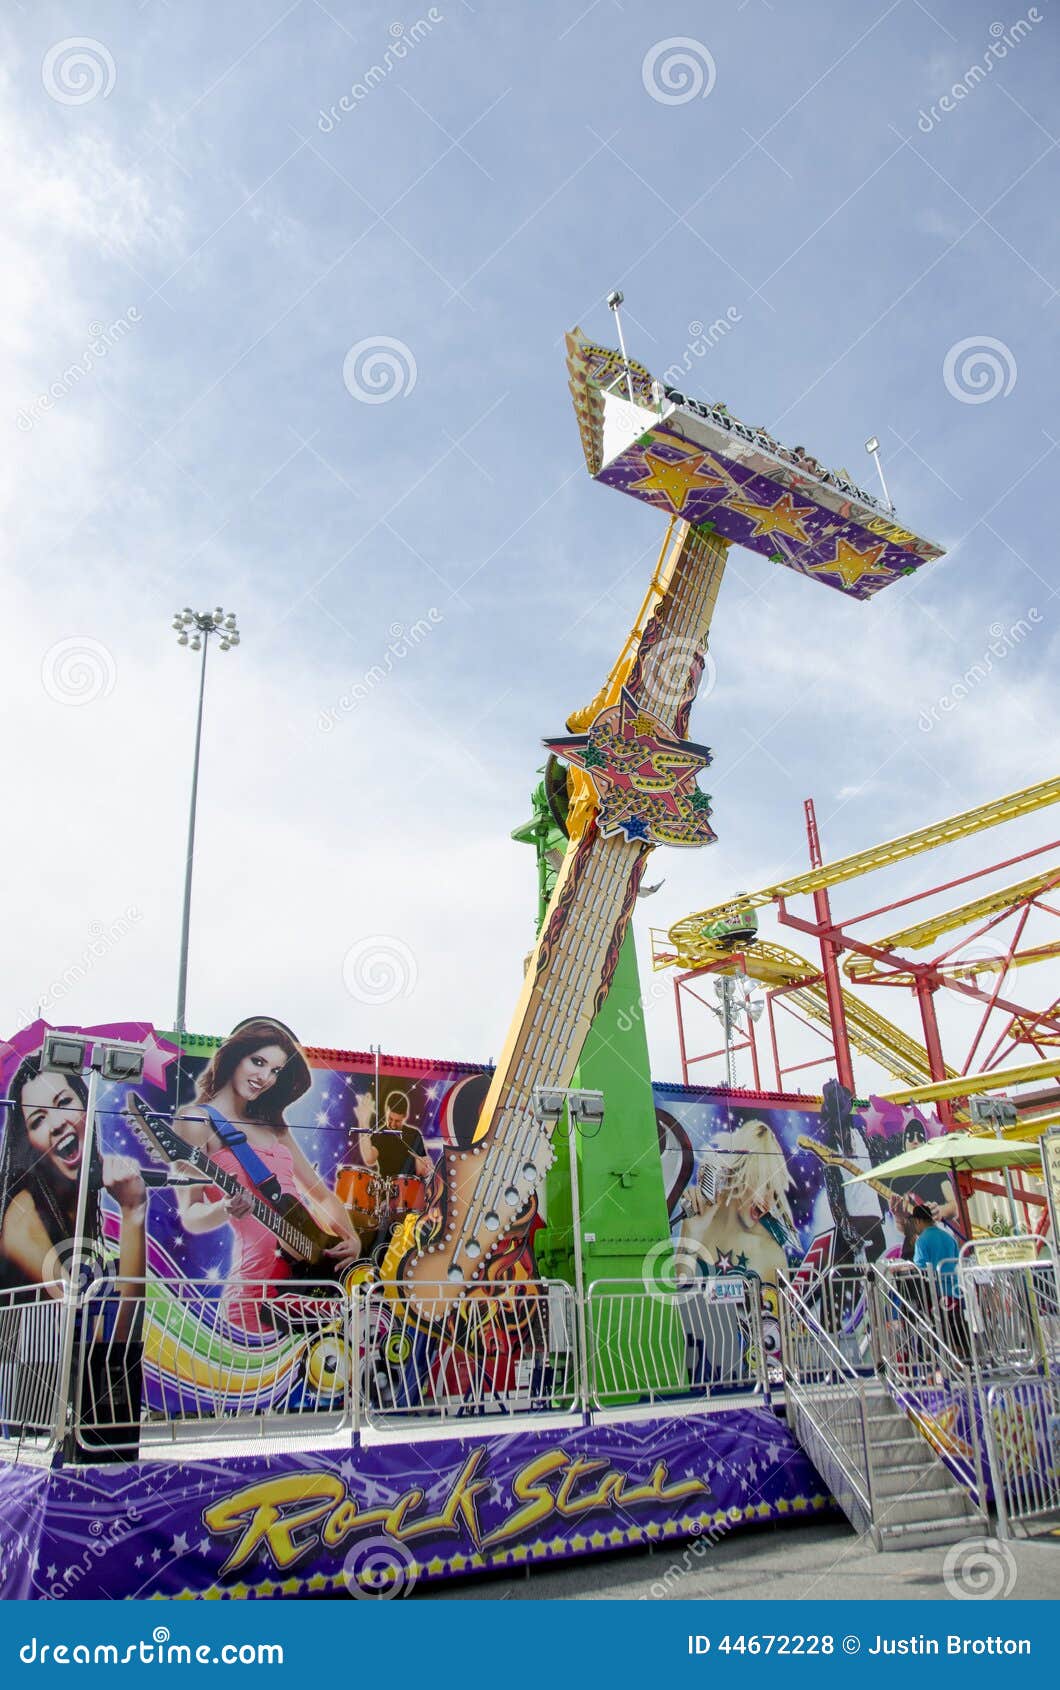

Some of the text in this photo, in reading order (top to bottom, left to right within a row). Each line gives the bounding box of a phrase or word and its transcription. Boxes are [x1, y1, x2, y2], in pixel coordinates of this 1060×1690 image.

[716, 1284, 743, 1297] EXIT
[202, 1445, 711, 1576] Rock Star
